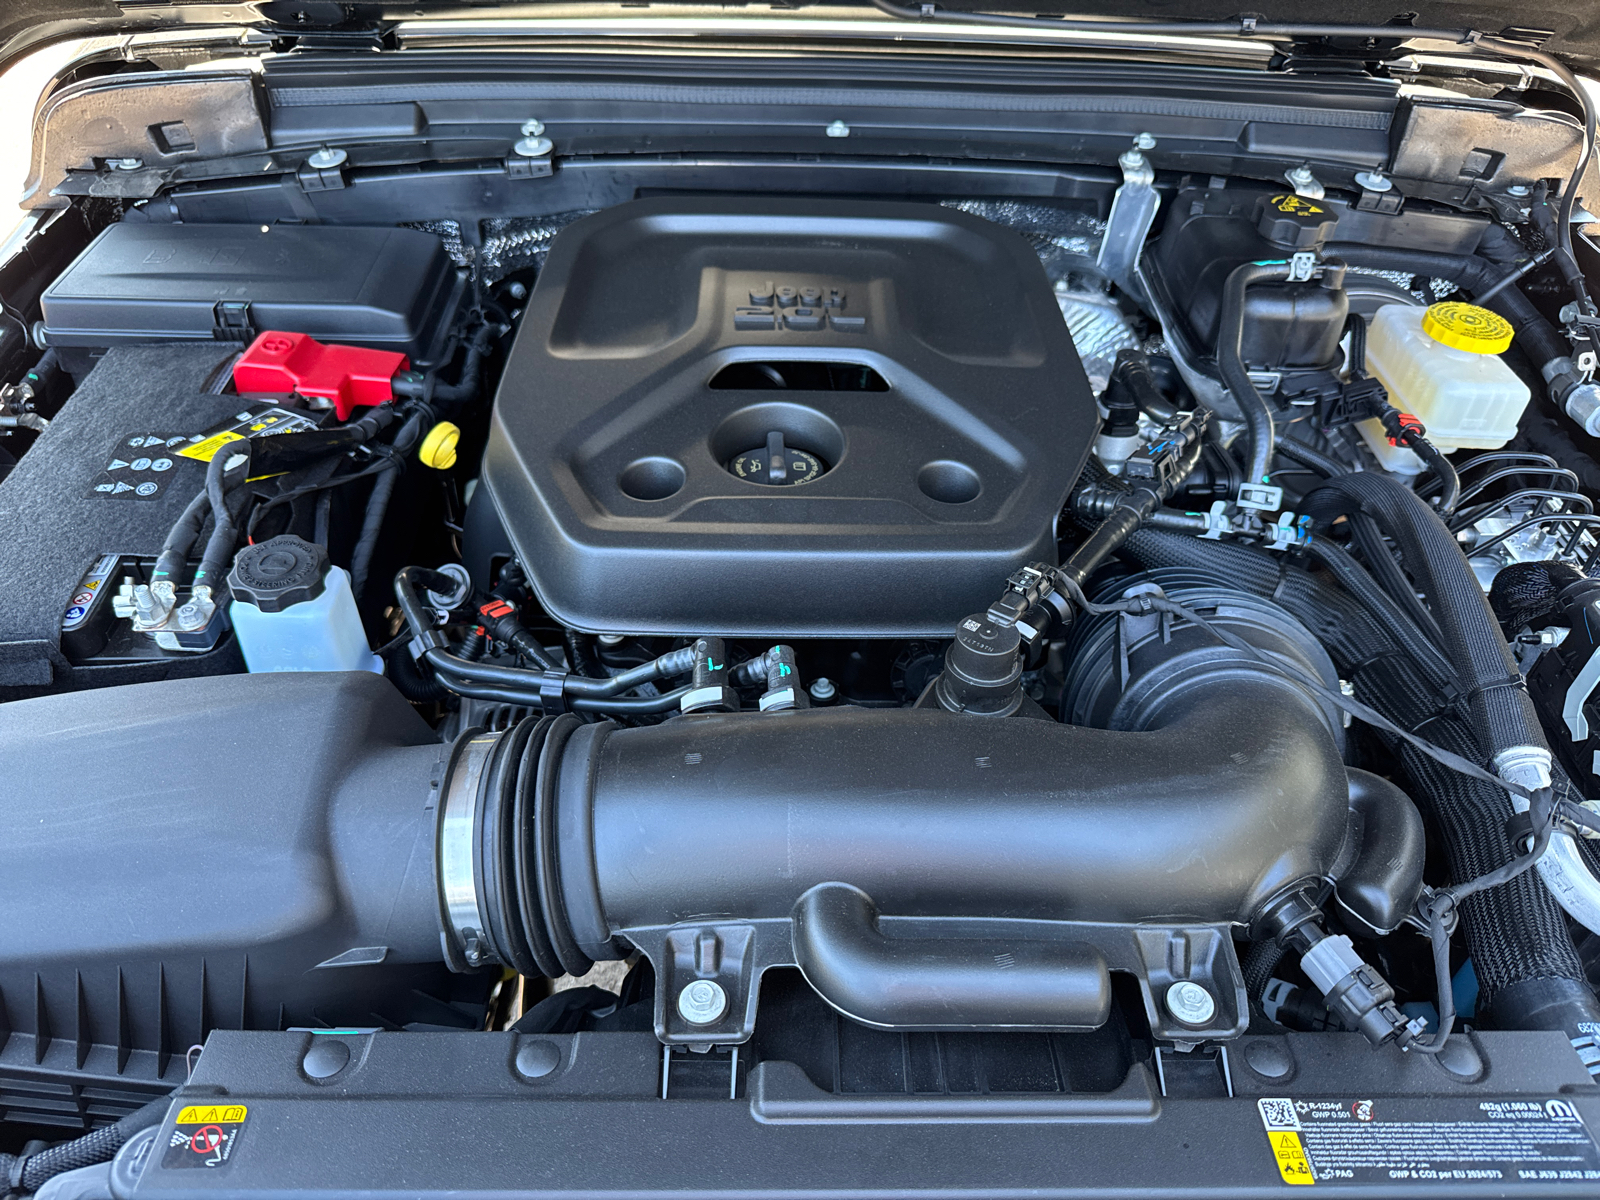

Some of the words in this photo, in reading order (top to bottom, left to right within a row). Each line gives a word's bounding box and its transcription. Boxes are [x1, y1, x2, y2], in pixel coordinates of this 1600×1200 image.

[749, 281, 846, 309] Jeep
[734, 305, 866, 331] 2.0L
[1335, 1169, 1354, 1178] PAG
[1389, 1169, 1410, 1179] GWP
[1419, 1169, 1438, 1179] CO2
